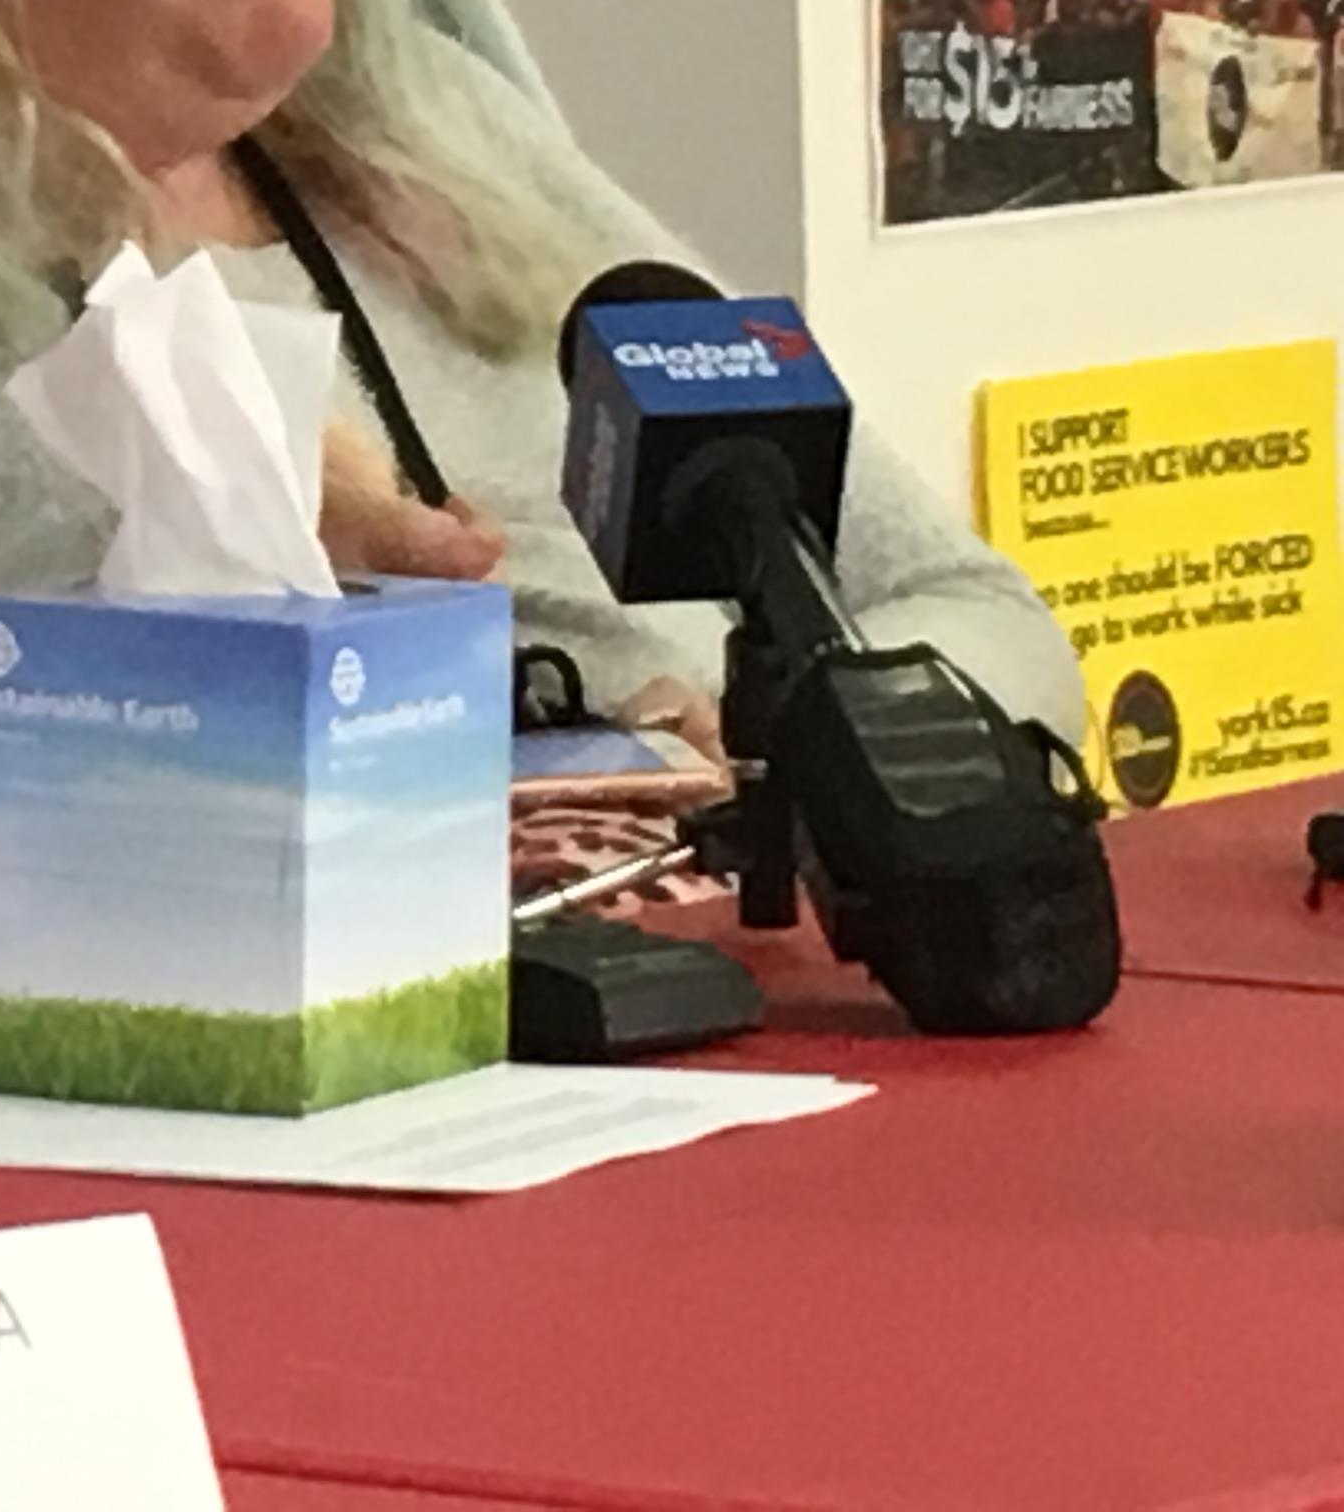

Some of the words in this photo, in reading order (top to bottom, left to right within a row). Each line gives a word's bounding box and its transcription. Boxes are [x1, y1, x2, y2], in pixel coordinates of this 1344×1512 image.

[614, 339, 770, 367] Global
[1029, 407, 1129, 457] SUPPORT
[1020, 462, 1083, 503] FOOD
[1090, 445, 1180, 495] SERVICE
[1183, 428, 1311, 477] WORKERS
[1107, 551, 1178, 600] should
[1180, 550, 1211, 586] be
[1215, 535, 1312, 580] FORCED
[1103, 615, 1125, 644] to
[1131, 597, 1187, 637] work
[1192, 586, 1256, 627] while
[1261, 578, 1303, 619] sick
